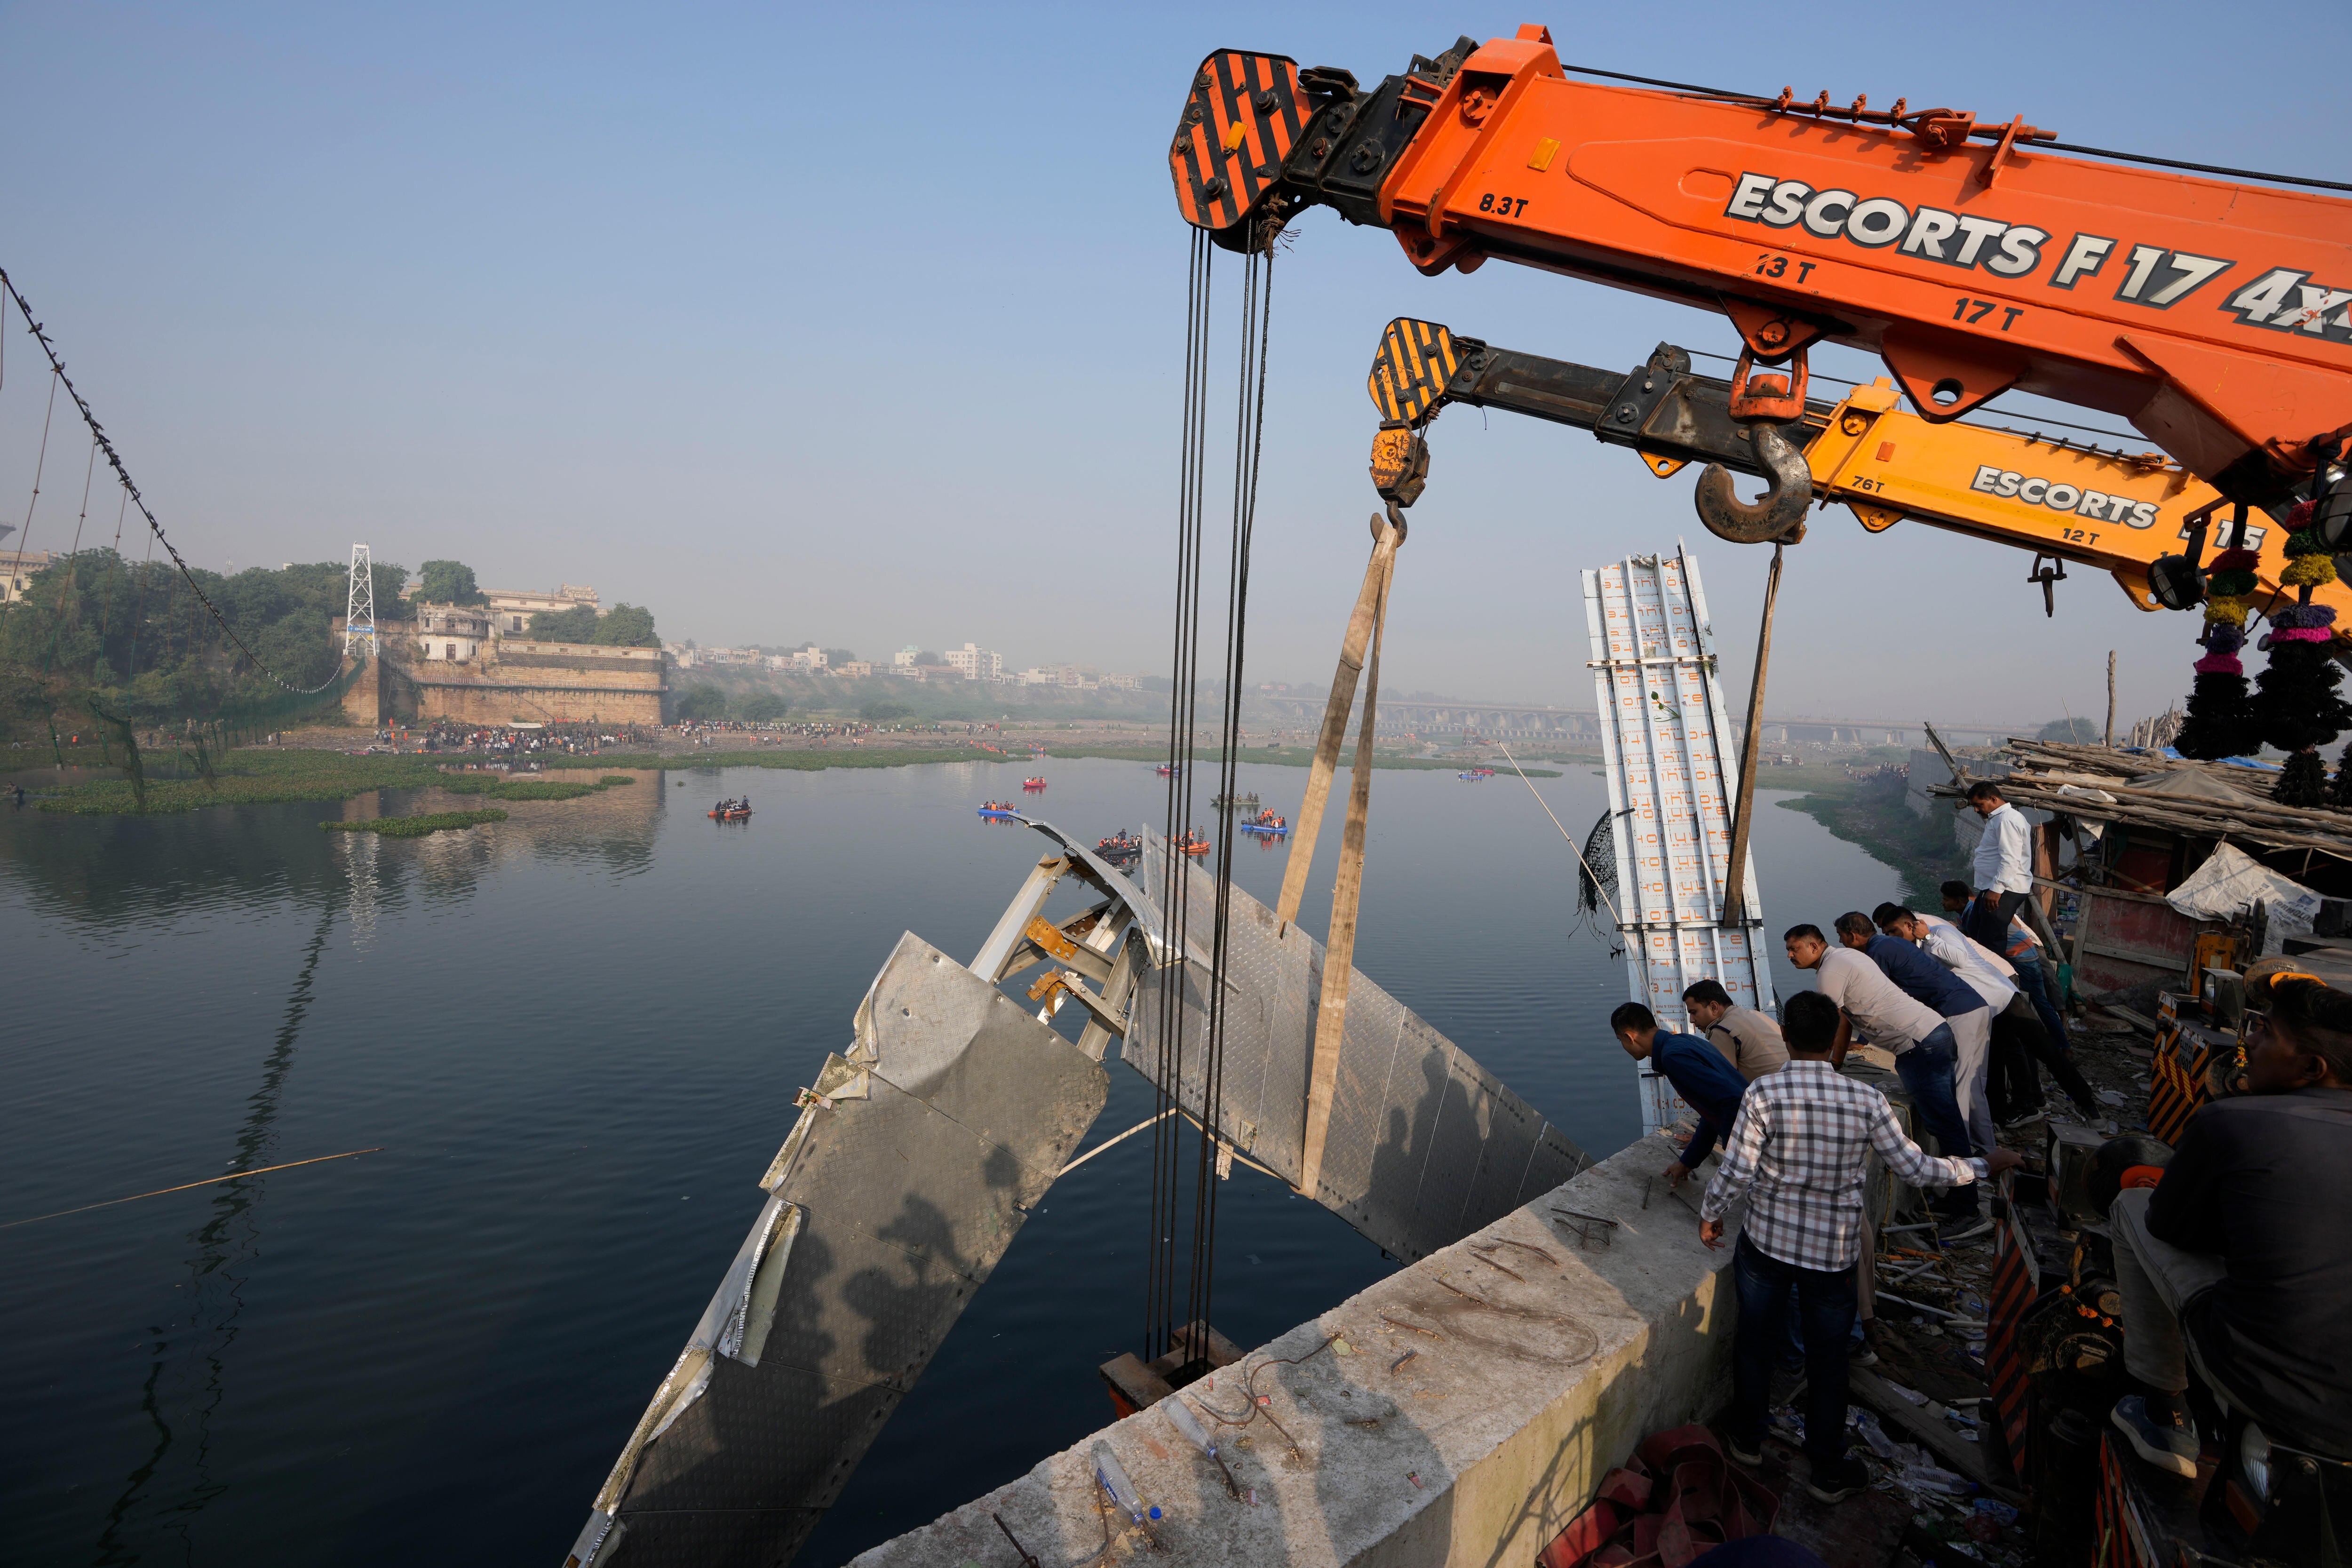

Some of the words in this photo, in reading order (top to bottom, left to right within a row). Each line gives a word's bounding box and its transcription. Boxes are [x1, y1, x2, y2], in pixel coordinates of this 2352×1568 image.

[1726, 173, 2049, 276] ESCORTS
[2052, 234, 2116, 287] F
[2117, 245, 2233, 307] 17
[1755, 254, 1788, 278] 13
[1796, 262, 1816, 284] T
[1953, 297, 1996, 324] 17
[2002, 306, 2024, 331] T
[1971, 466, 2159, 528] ESCORTS
[2214, 519, 2267, 550] 15
[2063, 528, 2085, 542] 12
[2089, 533, 2100, 545] T
